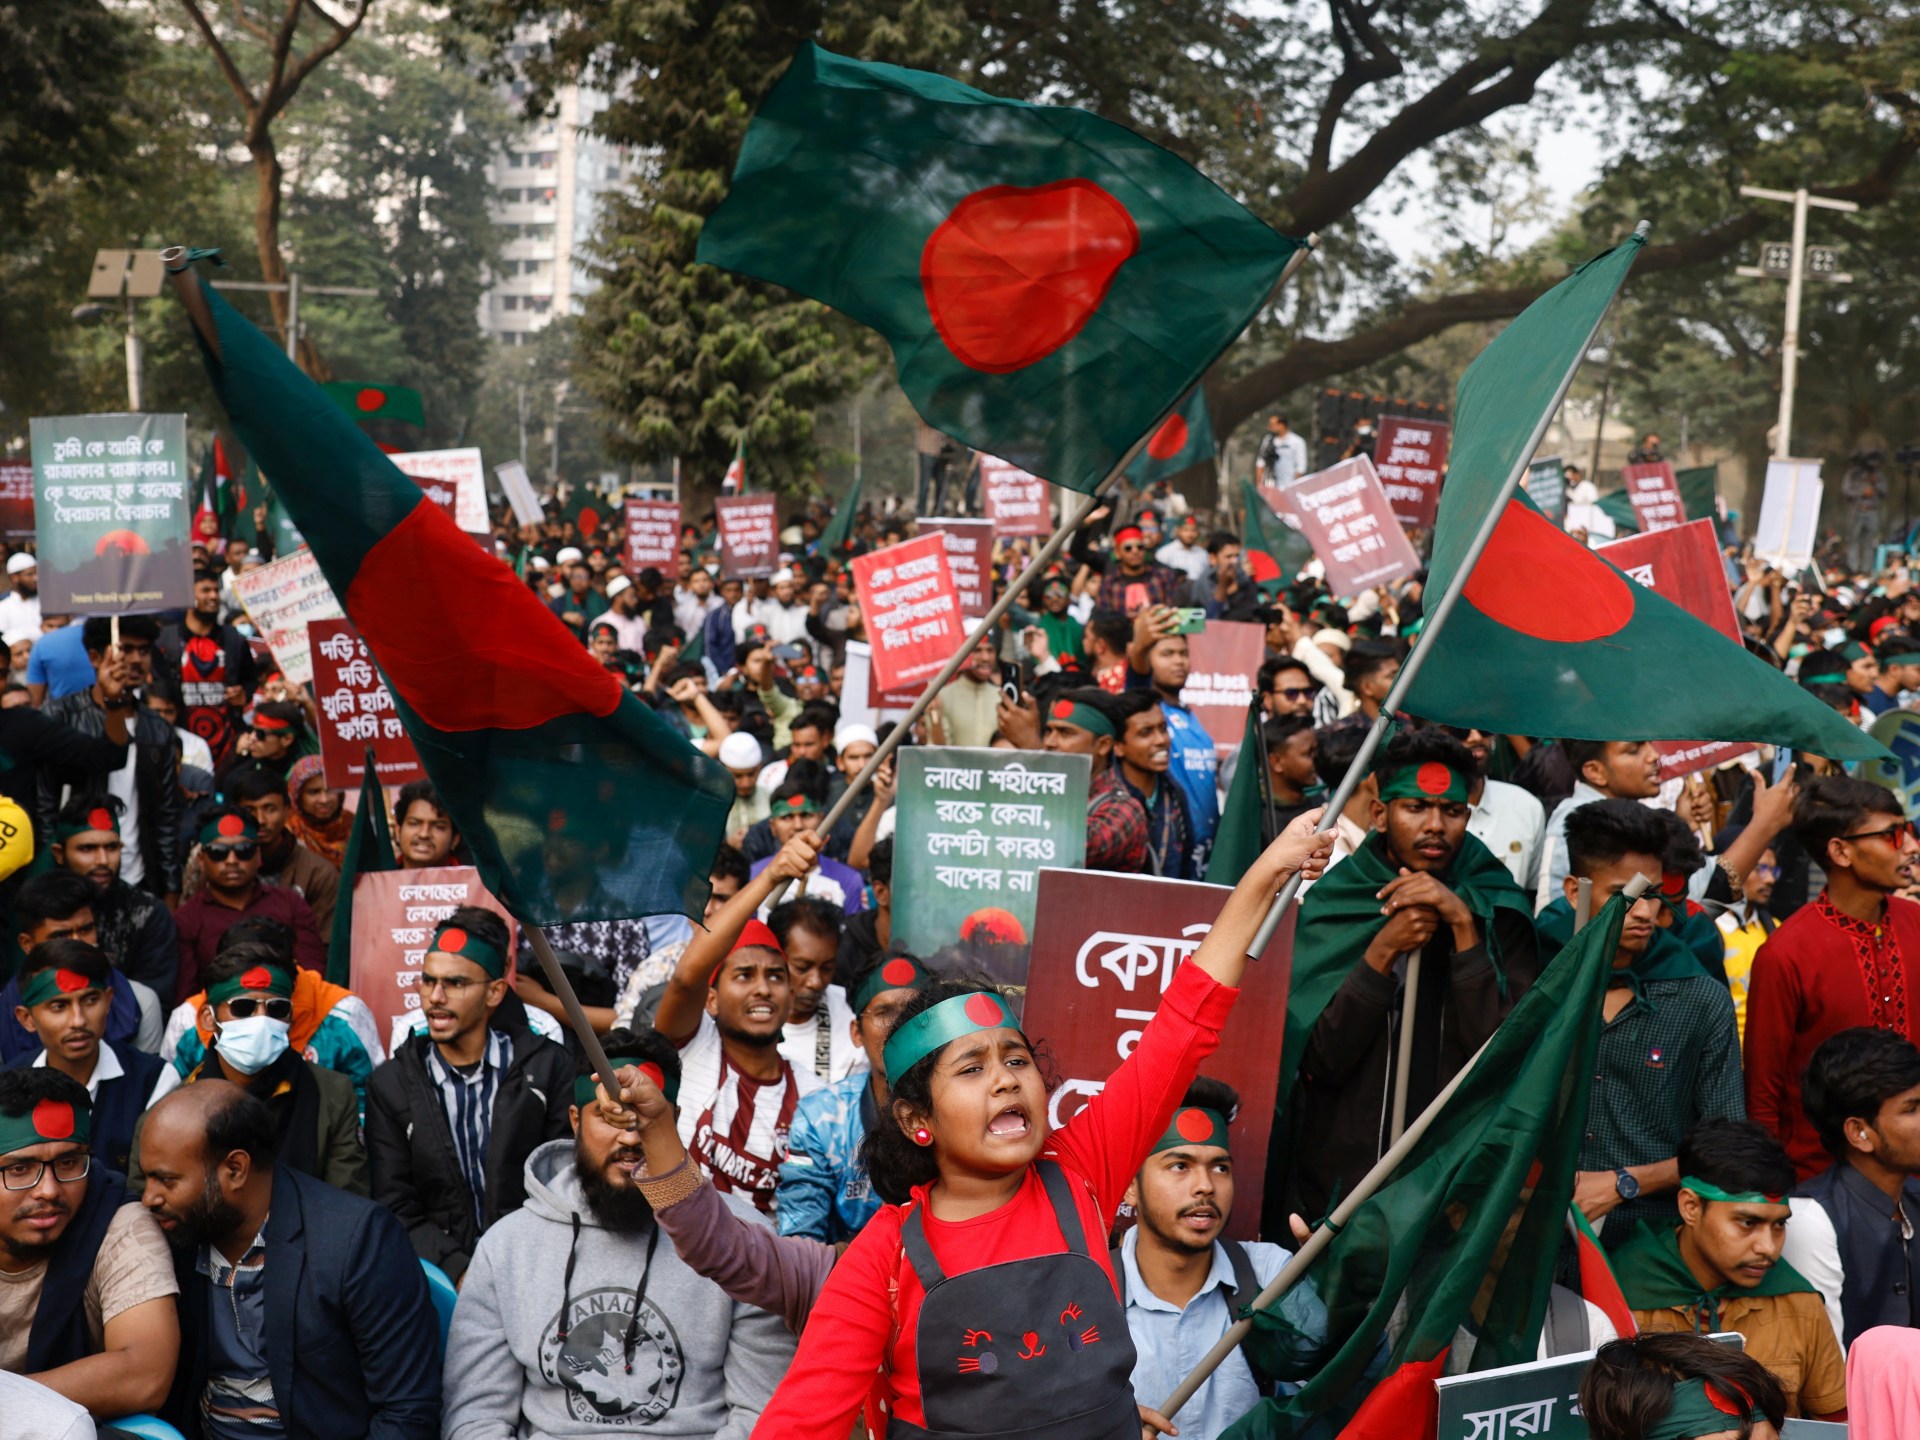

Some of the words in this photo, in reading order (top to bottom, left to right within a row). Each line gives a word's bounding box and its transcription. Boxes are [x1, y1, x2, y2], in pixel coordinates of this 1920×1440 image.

[53, 436, 82, 463] তুমি
[85, 440, 105, 458] কে
[107, 435, 142, 456] আমি
[145, 440, 165, 456] কে
[43, 462, 105, 480] রাজাকার
[44, 485, 64, 502] কে
[67, 484, 113, 502] বলেছে
[116, 483, 135, 500] কে
[138, 481, 183, 500] বলেছে
[54, 499, 111, 523] স্বৈরাচার
[114, 497, 170, 521] স্বৈরাচার
[319, 633, 354, 662] দড়ি
[337, 661, 372, 688] দড়ি
[321, 689, 355, 720] খুনি
[924, 766, 982, 792] লাখো
[988, 762, 1067, 795] শহীদের
[935, 800, 986, 824] রক্তে
[990, 802, 1051, 829] কেনা,
[927, 829, 991, 857] দেশটা
[995, 836, 1056, 860] কারও
[935, 865, 1002, 890] বাপের
[1008, 870, 1035, 892] না
[398, 883, 468, 902] লেগেছেরে
[391, 928, 427, 945] রক্তে
[1463, 1397, 1558, 1440] সারা
